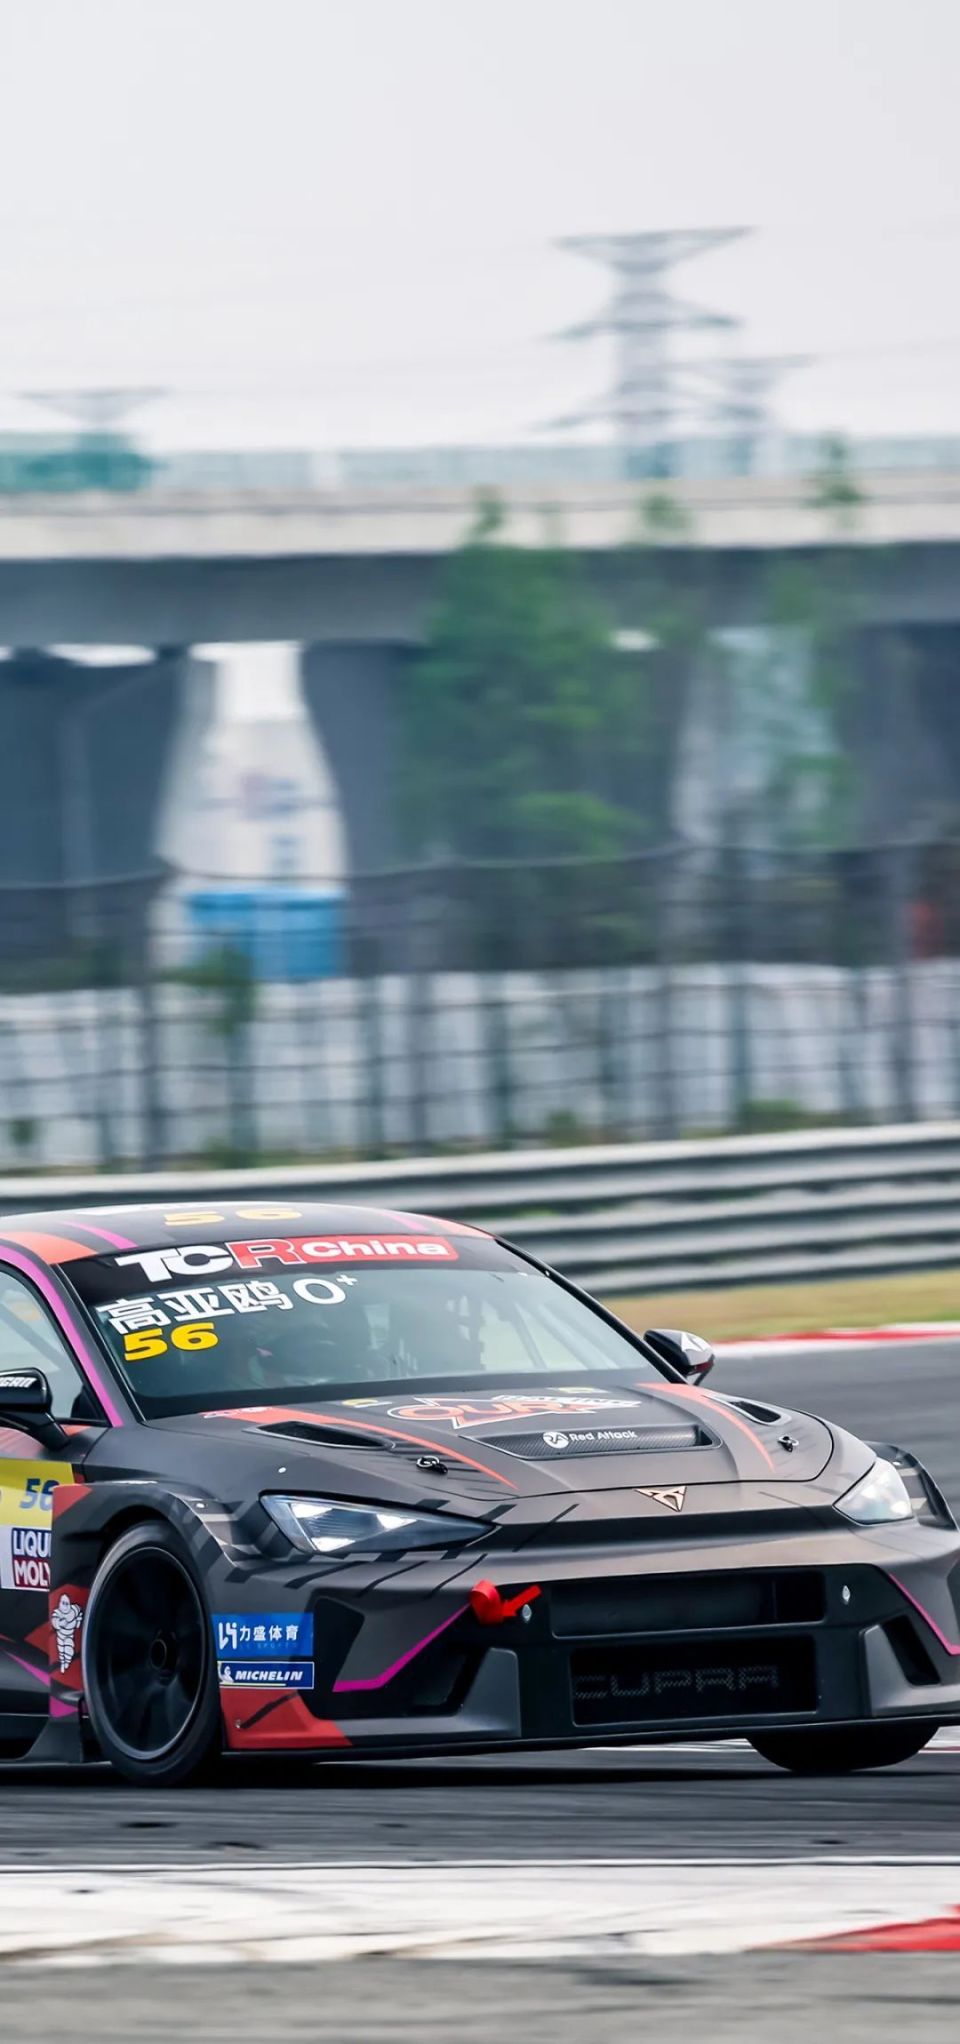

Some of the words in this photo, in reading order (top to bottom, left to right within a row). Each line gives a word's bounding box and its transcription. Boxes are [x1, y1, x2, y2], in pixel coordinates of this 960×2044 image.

[164, 1208, 302, 1226] 56
[115, 1239, 306, 1283] TCR
[302, 1240, 450, 1258] China
[95, 1280, 293, 1334] 高亚鸥
[124, 1322, 219, 1361] 56
[570, 1432, 595, 1442] Red
[597, 1430, 638, 1440] Attack
[19, 1478, 60, 1511] 56
[239, 1625, 299, 1641] 力盛体育
[235, 1671, 303, 1681] MICHELIN
[574, 1665, 779, 1699] CUPRA
